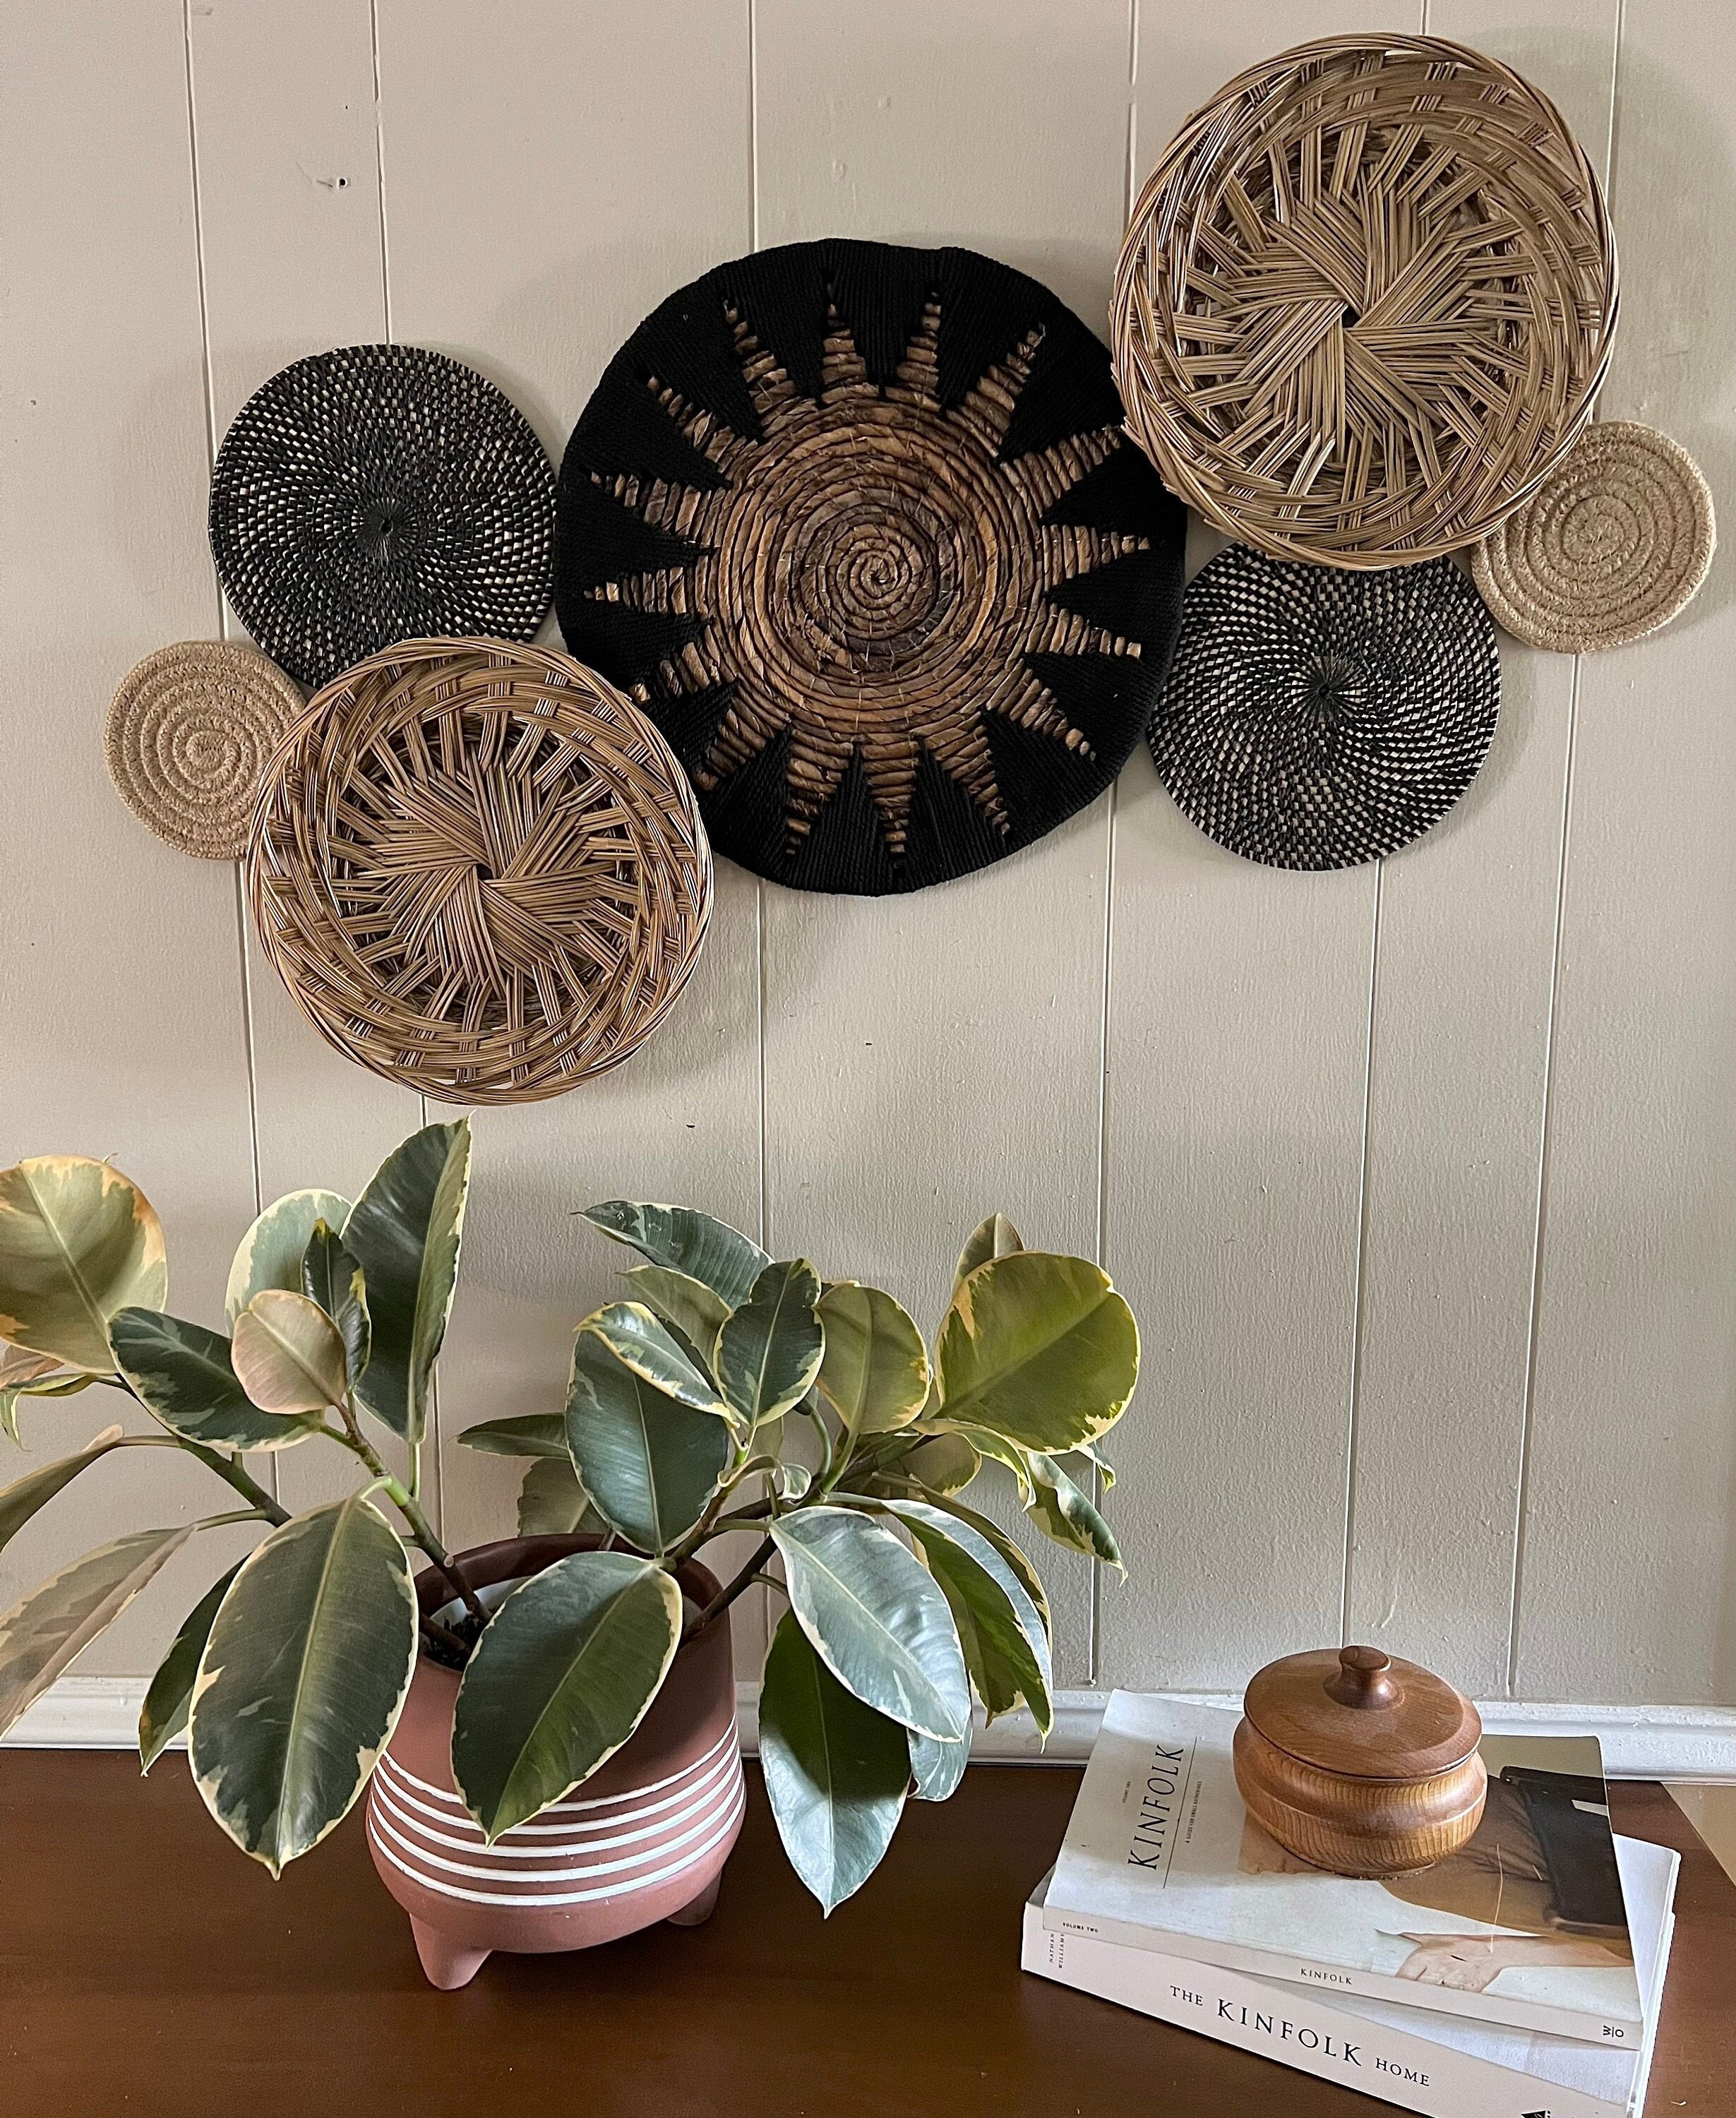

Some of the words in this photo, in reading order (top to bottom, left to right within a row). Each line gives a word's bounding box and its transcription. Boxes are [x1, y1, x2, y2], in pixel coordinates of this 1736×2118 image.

[1127, 1745, 1184, 1870] KINFOLK
[1300, 1968, 1353, 1985] KINFOLK
[1170, 1985, 1203, 2006] THE
[1218, 1998, 1362, 2066] KINFOLK
[1375, 2057, 1430, 2086] HOME
